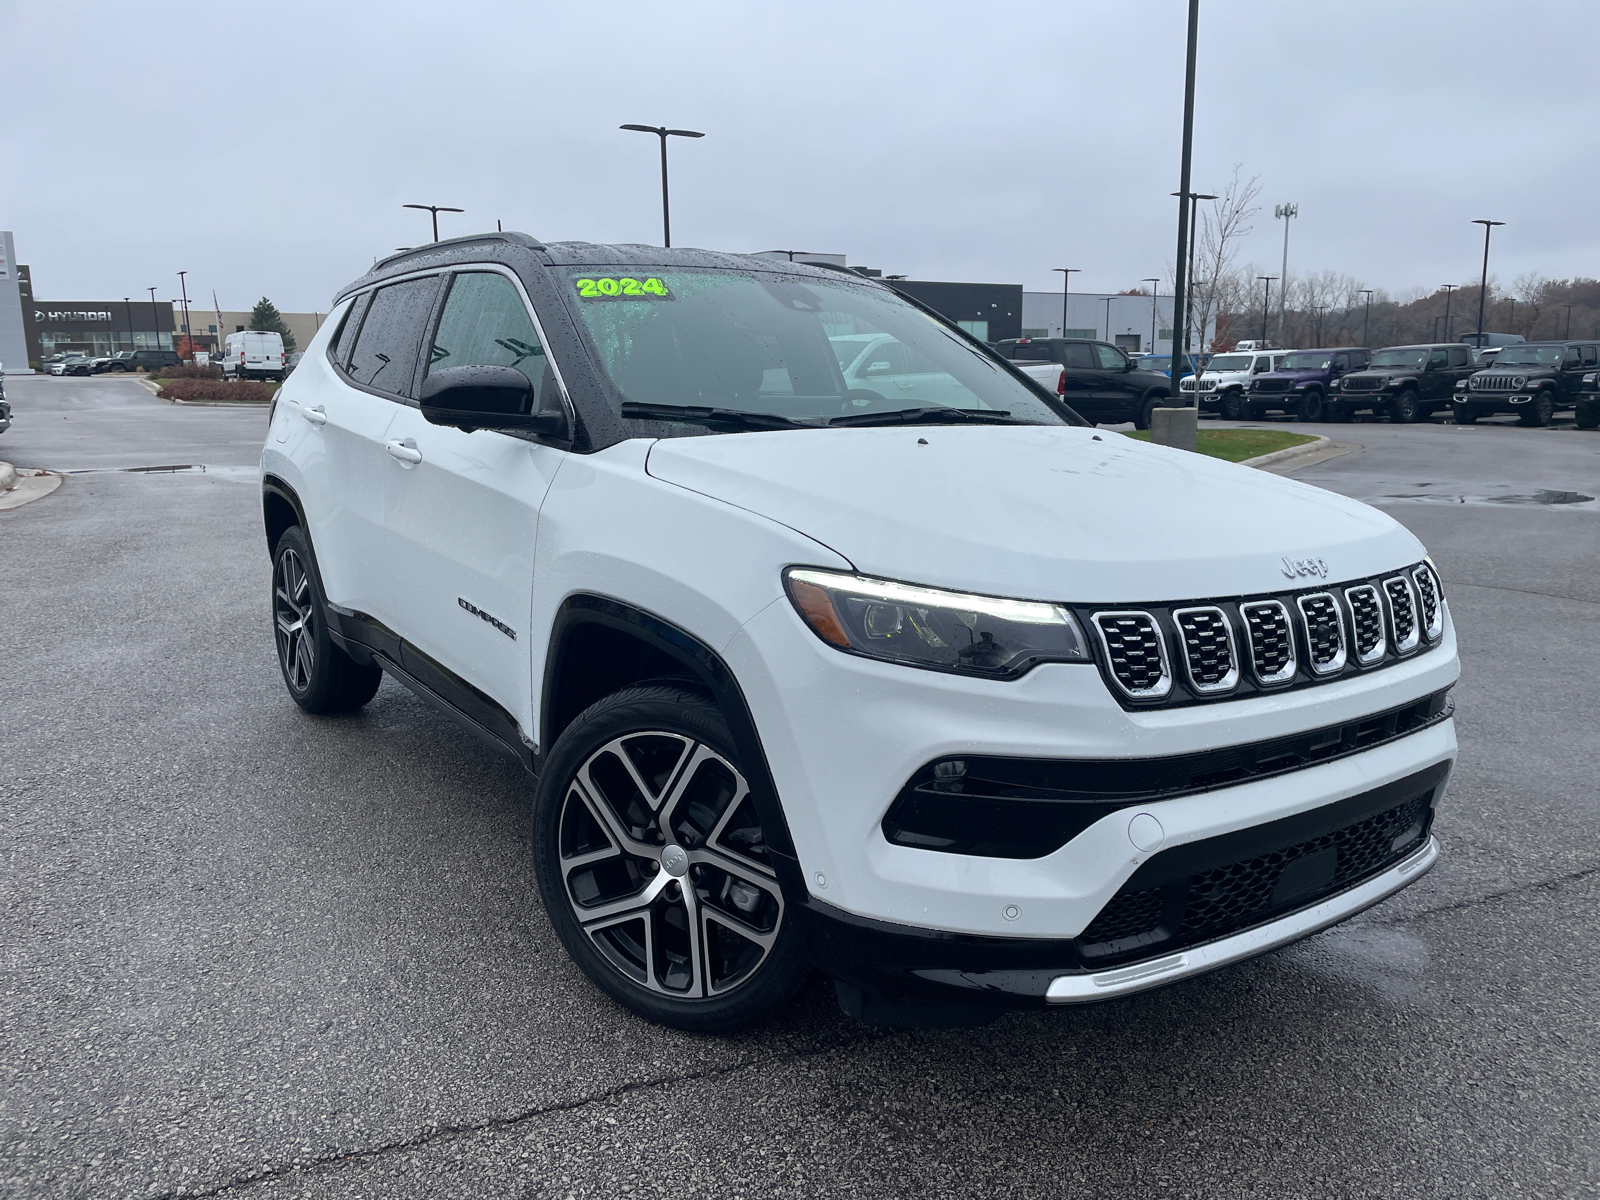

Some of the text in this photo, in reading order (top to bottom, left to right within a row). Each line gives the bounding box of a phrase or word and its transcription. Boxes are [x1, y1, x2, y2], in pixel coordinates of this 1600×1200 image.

[577, 278, 668, 297] 2024
[48, 311, 112, 321] HYUNDAI
[1281, 556, 1328, 579] Jeep
[458, 597, 517, 641] COMPASS
[666, 852, 683, 869] Jeep
